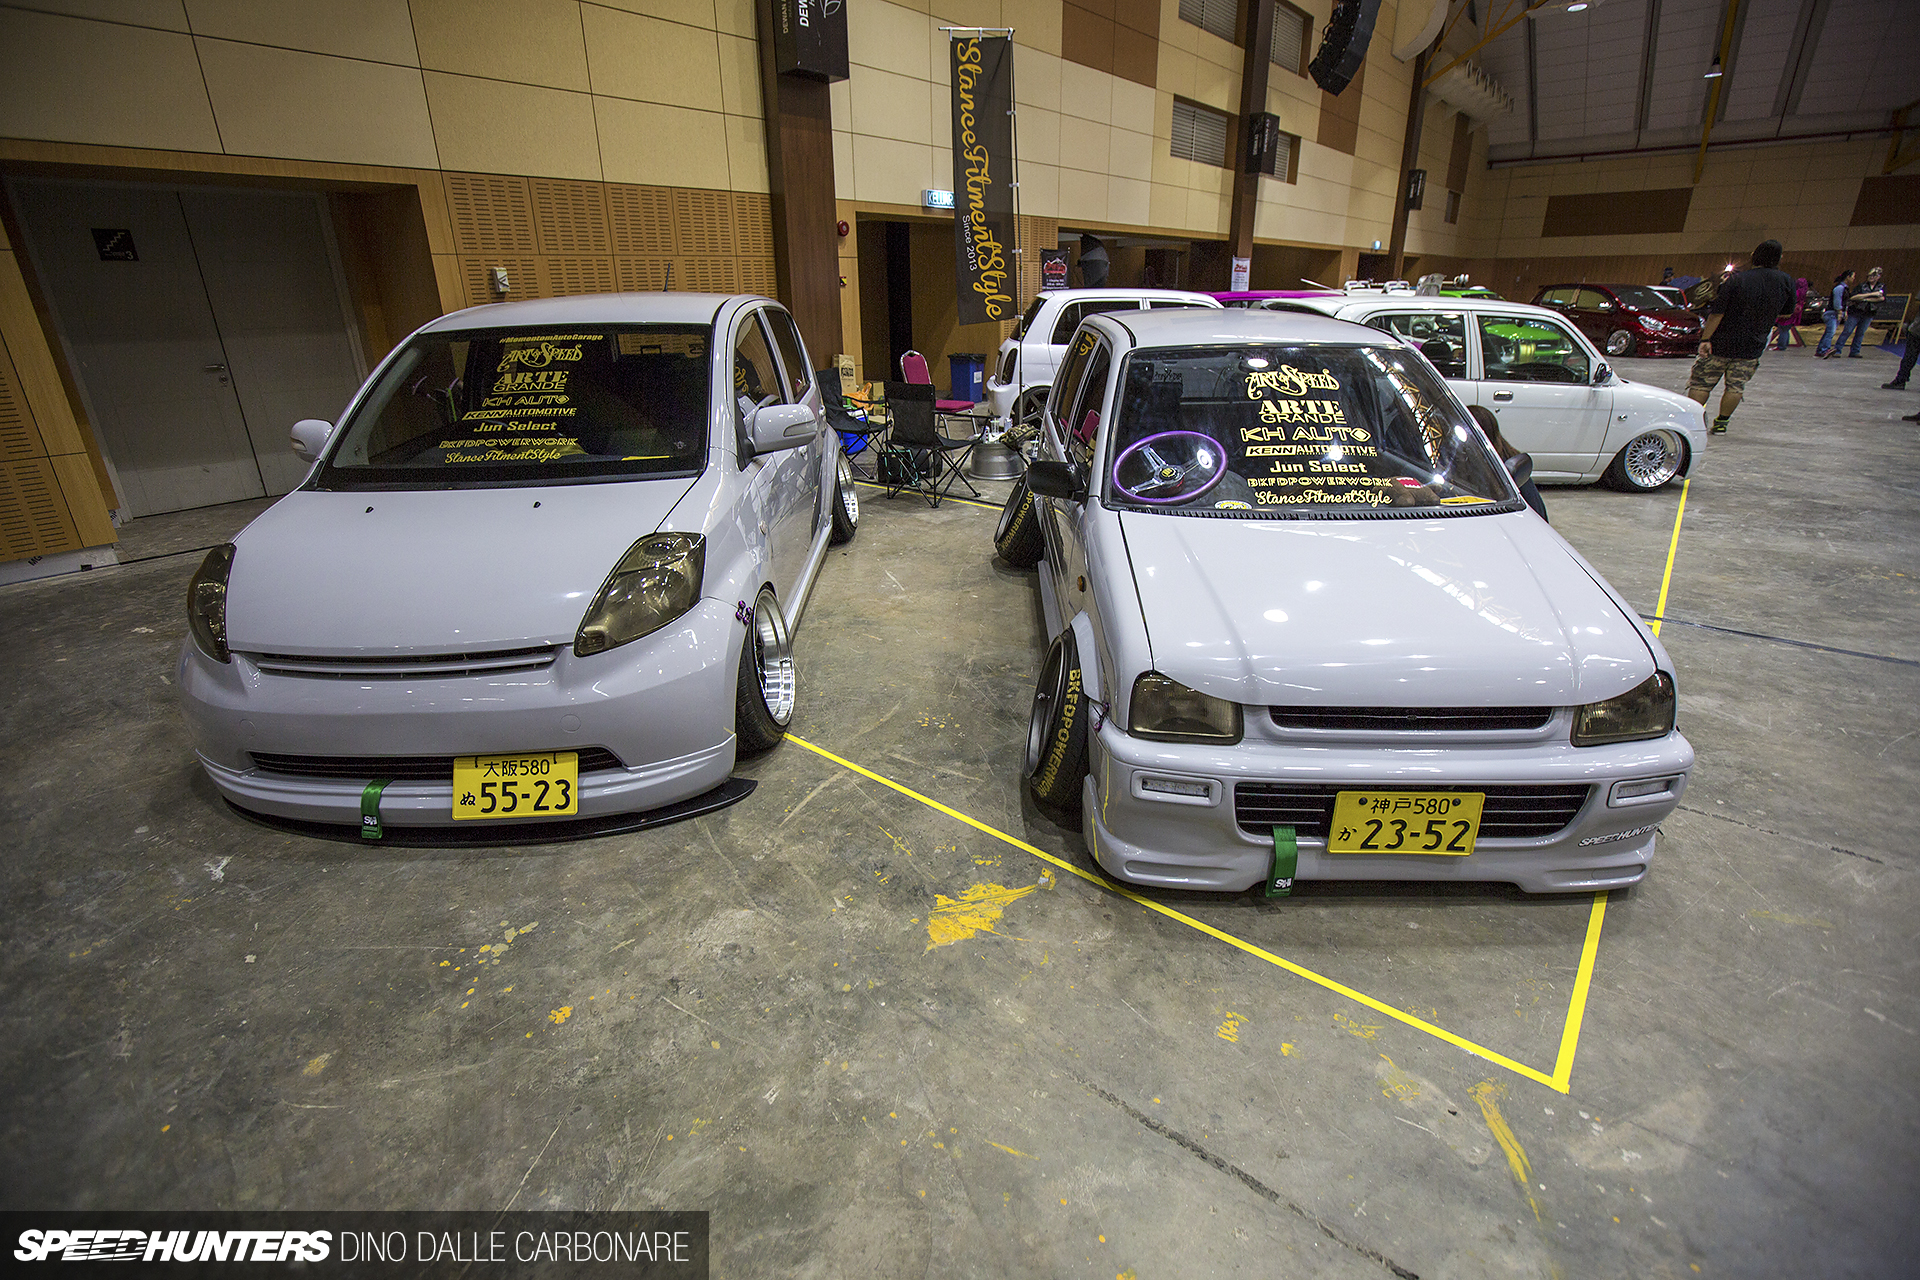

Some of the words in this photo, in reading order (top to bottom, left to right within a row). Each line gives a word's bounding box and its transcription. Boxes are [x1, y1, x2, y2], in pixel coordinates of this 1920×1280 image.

[962, 214, 972, 244] Since
[966, 245, 978, 271] 2013
[494, 371, 569, 385] ARTE
[493, 381, 565, 392] GRANDE
[481, 396, 512, 407] KH
[1258, 400, 1344, 415] ARTE
[1260, 413, 1347, 424] GRANDE
[473, 422, 503, 432] Jun
[506, 421, 557, 431] Select
[1240, 427, 1286, 443] KH
[1292, 427, 1371, 442] AUTO
[445, 449, 562, 463] StanceFitmentStyle
[1269, 460, 1304, 473] Jun
[1308, 460, 1368, 473] Select
[1254, 489, 1393, 508] StanceFitmentStyle
[459, 791, 476, 806] ぬ
[480, 779, 572, 813] 55-23
[1338, 826, 1358, 841] か
[1360, 819, 1471, 852] 23-52
